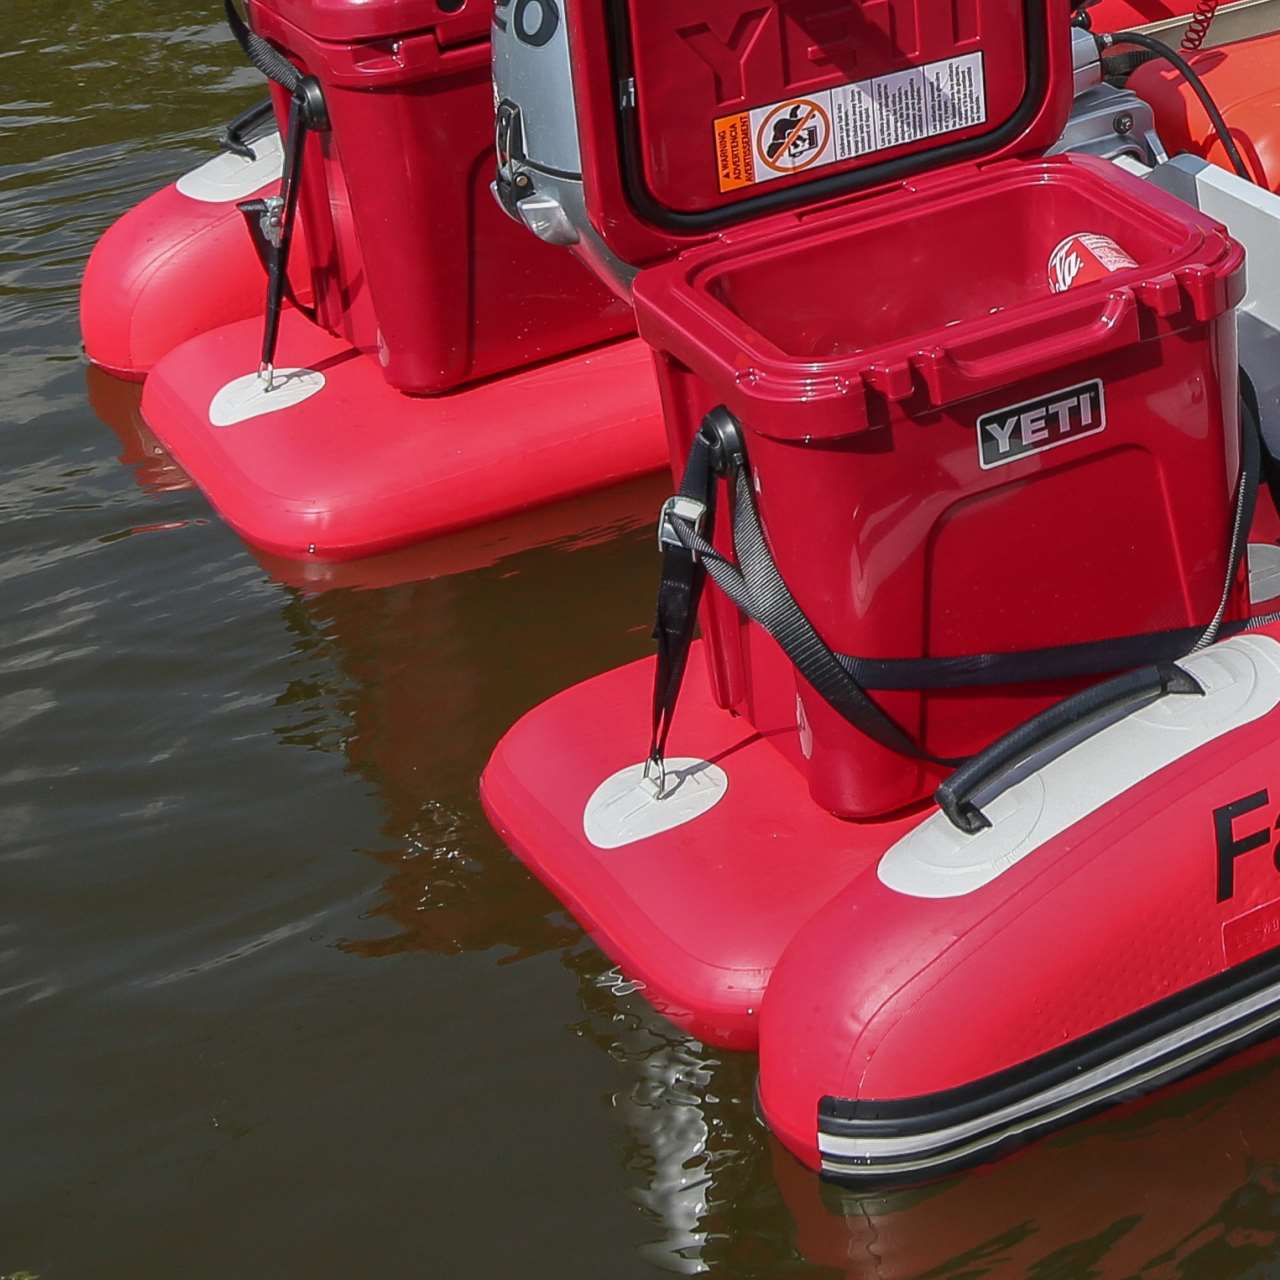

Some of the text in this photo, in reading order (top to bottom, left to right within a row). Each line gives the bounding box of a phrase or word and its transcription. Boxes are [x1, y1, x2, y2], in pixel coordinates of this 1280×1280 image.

[718, 130, 729, 169] WARNING
[729, 123, 742, 180] ADVERTENCIA
[740, 116, 753, 182] AVERTISSEMENT
[985, 392, 1092, 453] YETI
